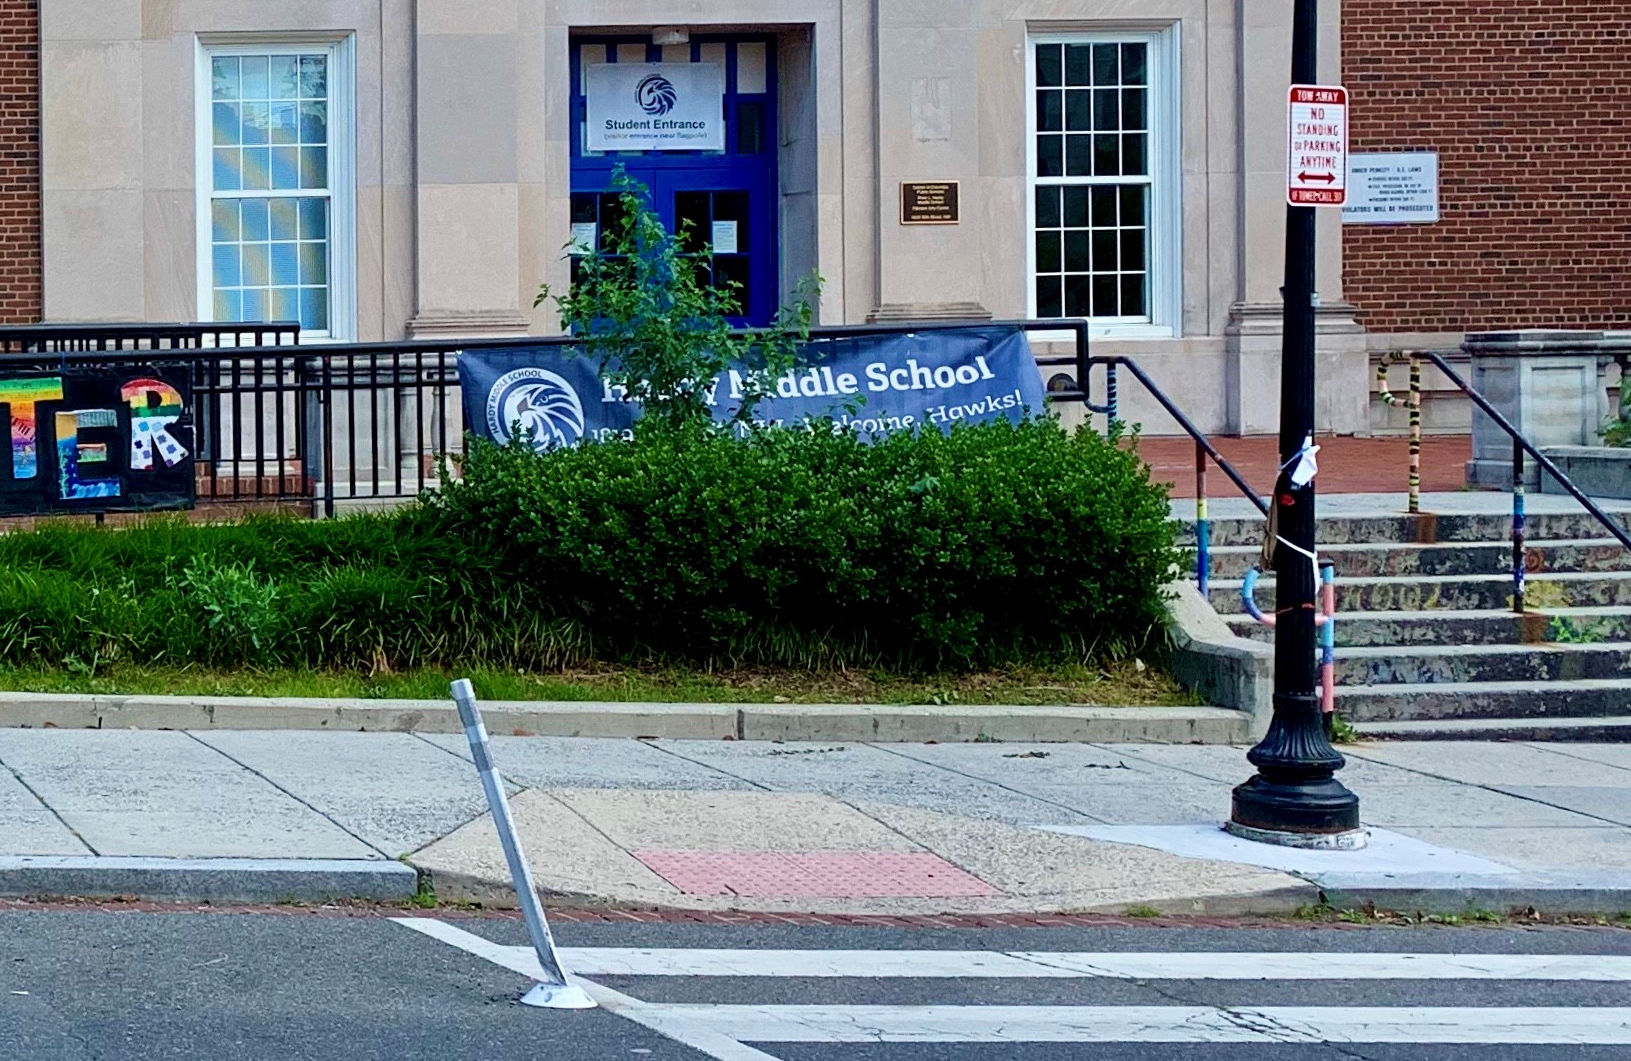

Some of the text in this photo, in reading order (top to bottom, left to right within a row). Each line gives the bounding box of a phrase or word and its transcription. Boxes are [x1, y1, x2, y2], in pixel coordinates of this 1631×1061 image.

[1297, 89, 1314, 102] TOW
[1310, 107, 1325, 120] NO
[605, 119, 706, 130] Student Entrance
[1297, 123, 1339, 137] STANDING
[1303, 140, 1341, 153] PARKING
[1300, 156, 1337, 169] ANYTIME
[508, 369, 544, 383] SCHOOL
[865, 355, 996, 392] School
[490, 378, 510, 403] MIDDLE
[926, 388, 1024, 424] Hawks!
[487, 403, 501, 435] HARDY
